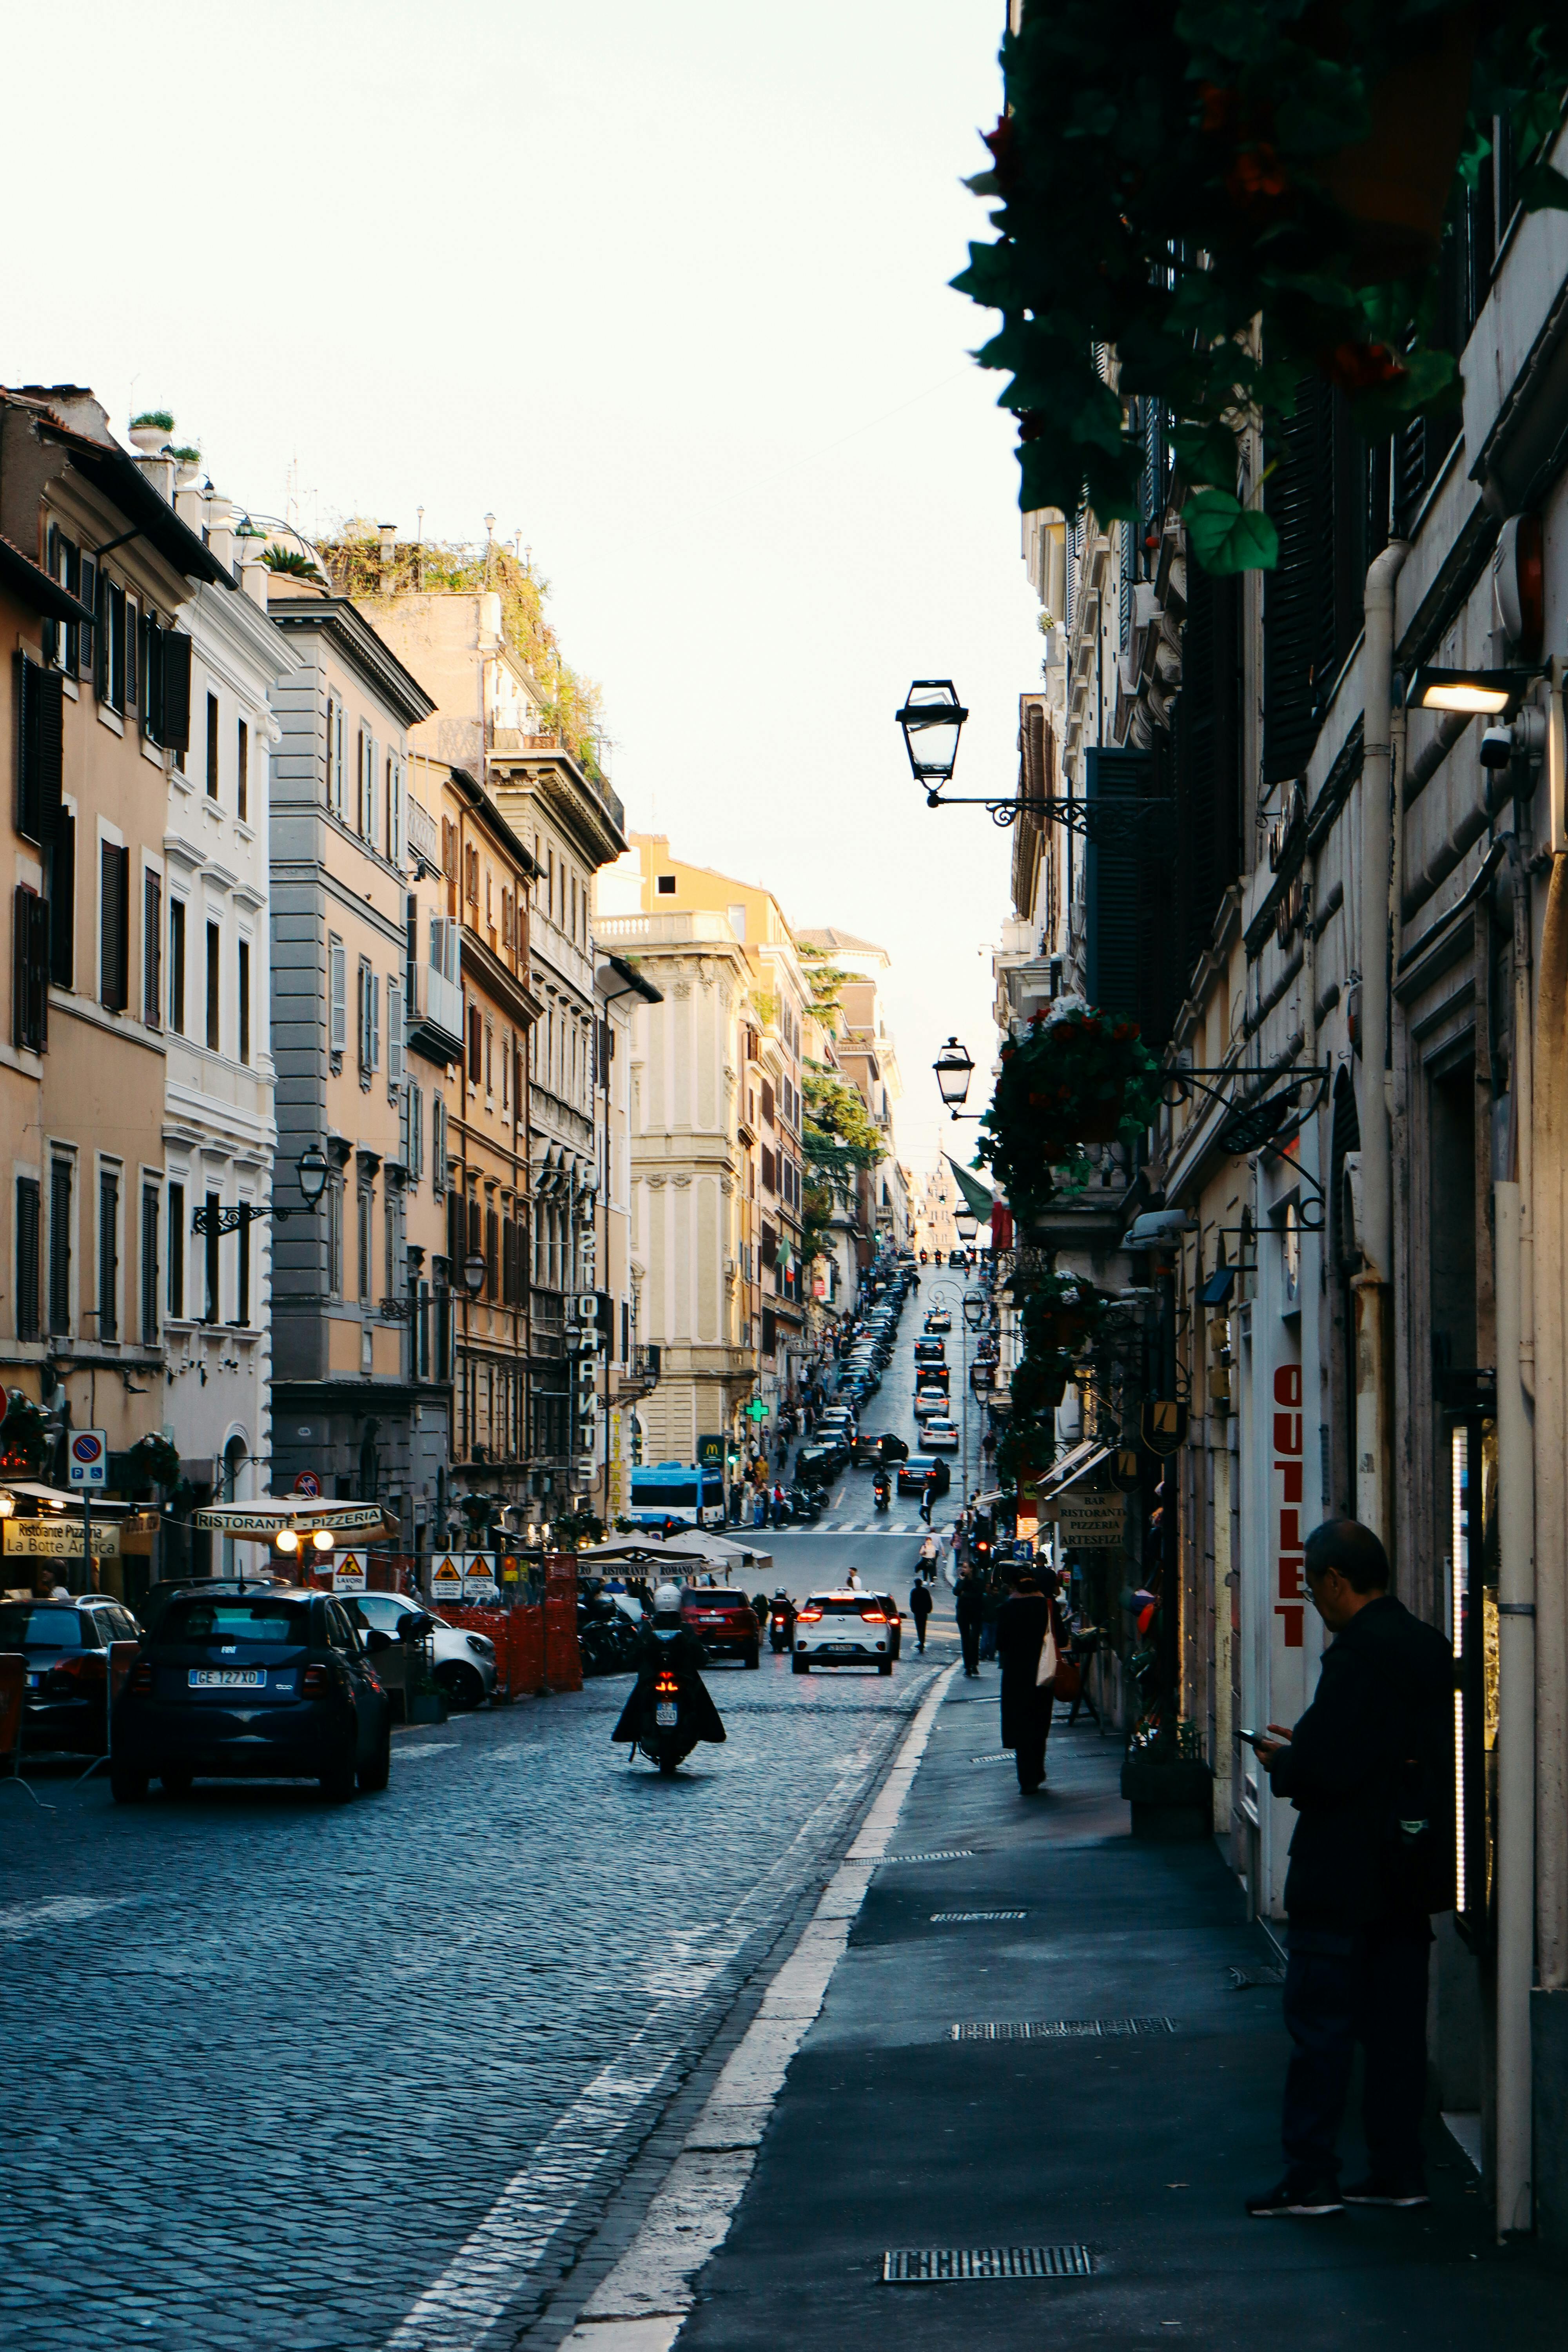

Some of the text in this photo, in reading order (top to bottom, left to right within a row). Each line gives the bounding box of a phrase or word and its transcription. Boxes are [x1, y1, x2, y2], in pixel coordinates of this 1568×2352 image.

[1084, 1497, 1106, 1505] BAR
[1274, 1364, 1304, 1647] OUTLET
[198, 1515, 294, 1529] RISTORANTE
[312, 1510, 379, 1527] PIZZERIA
[1070, 1521, 1120, 1529] PIZZERIA
[18, 1523, 102, 1539] Ristorante Pizzria
[1060, 1534, 1124, 1544] ARTESFIZI
[7, 1539, 23, 1552] La
[29, 1539, 64, 1552] Botte
[602, 1566, 650, 1575] RISTORANTE
[660, 1565, 693, 1575] ROMANO
